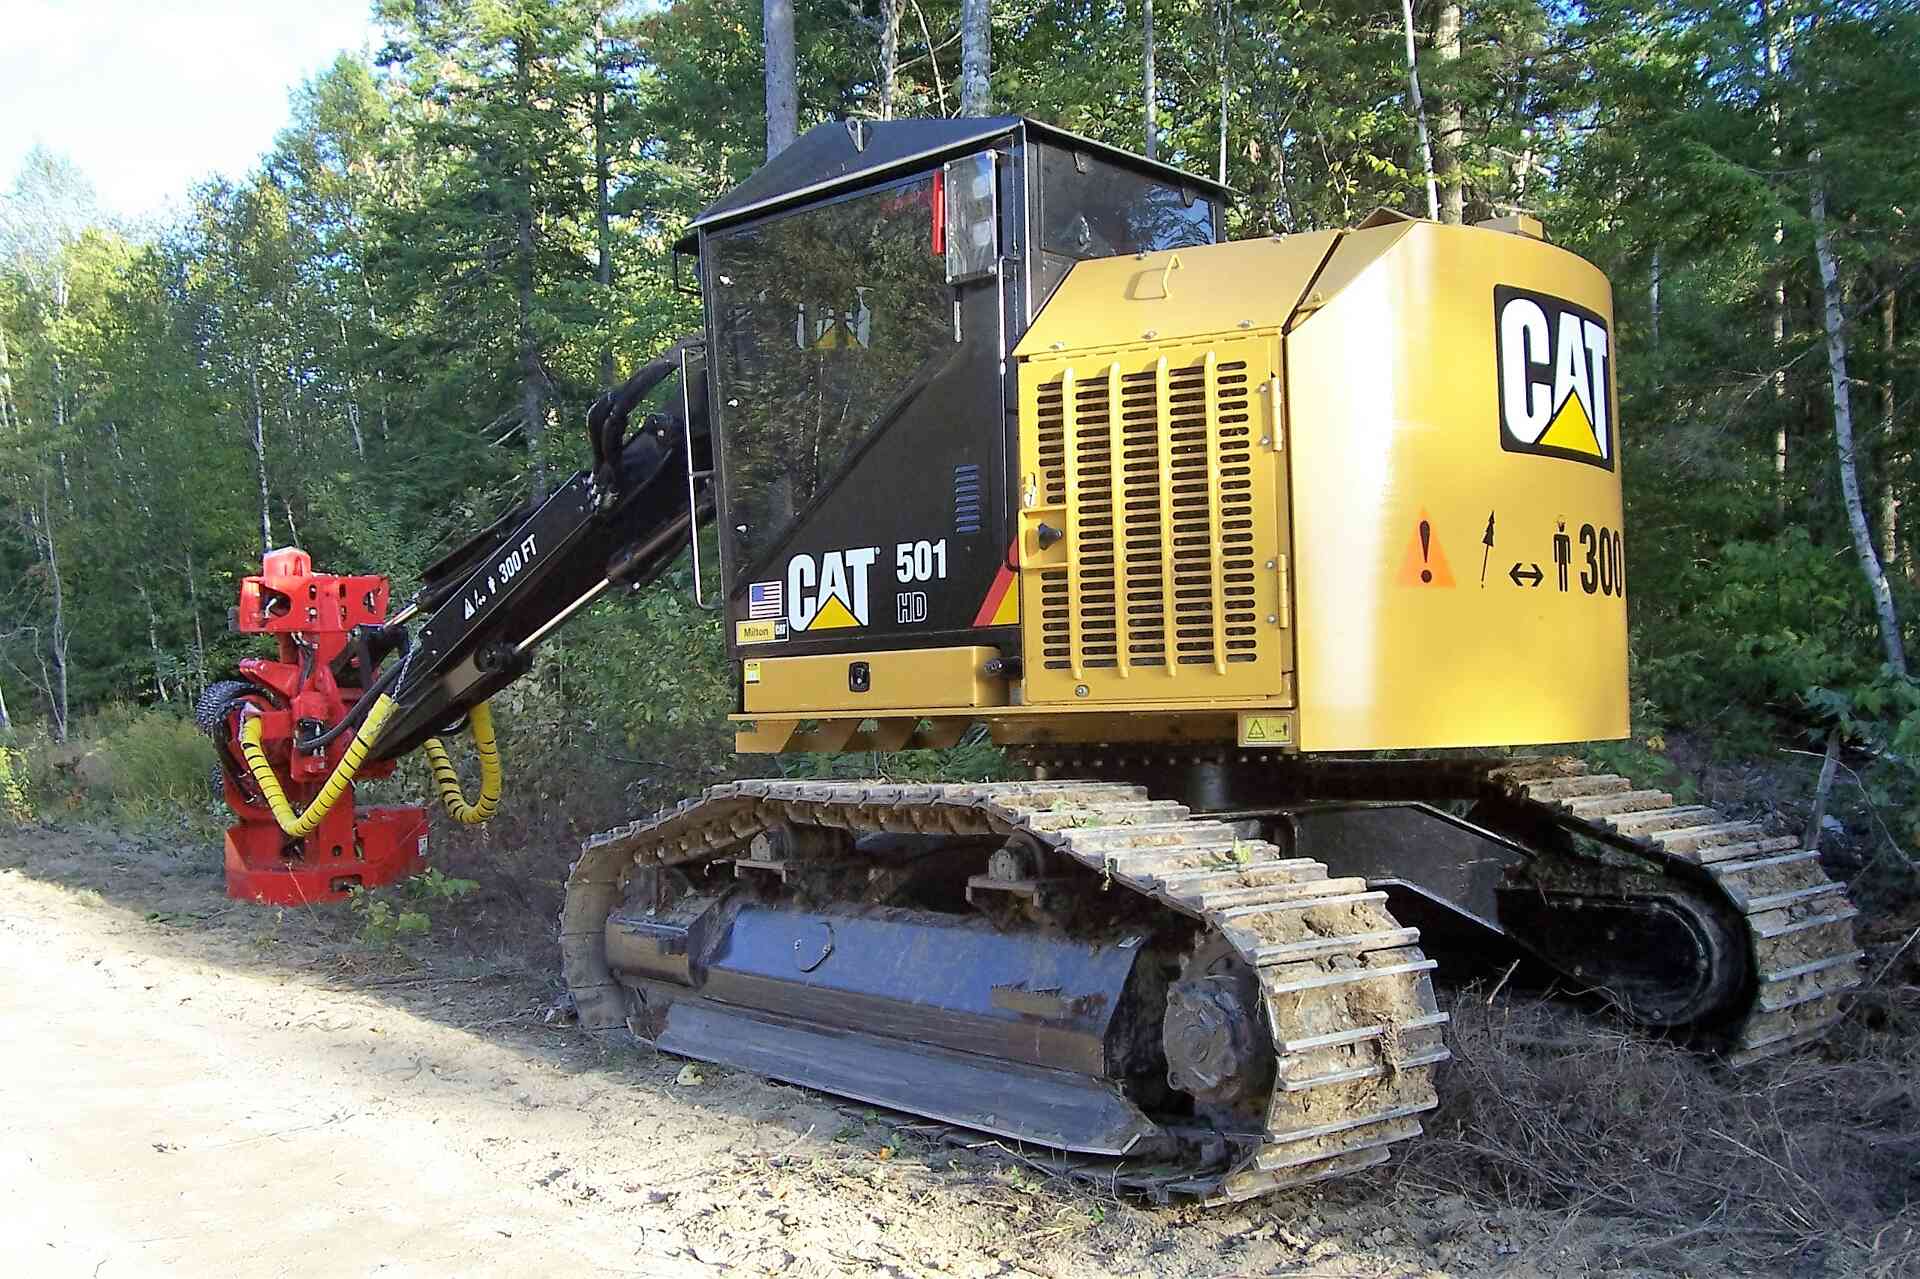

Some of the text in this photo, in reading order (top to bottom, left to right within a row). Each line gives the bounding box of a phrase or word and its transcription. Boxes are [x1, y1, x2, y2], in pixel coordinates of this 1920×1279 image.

[1501, 298, 1608, 460] CAT
[498, 533, 537, 584] 300 FT
[787, 539, 947, 632] CAT 501
[1579, 523, 1623, 598] 300
[743, 627, 769, 638] Milton
[897, 591, 928, 623] HD
